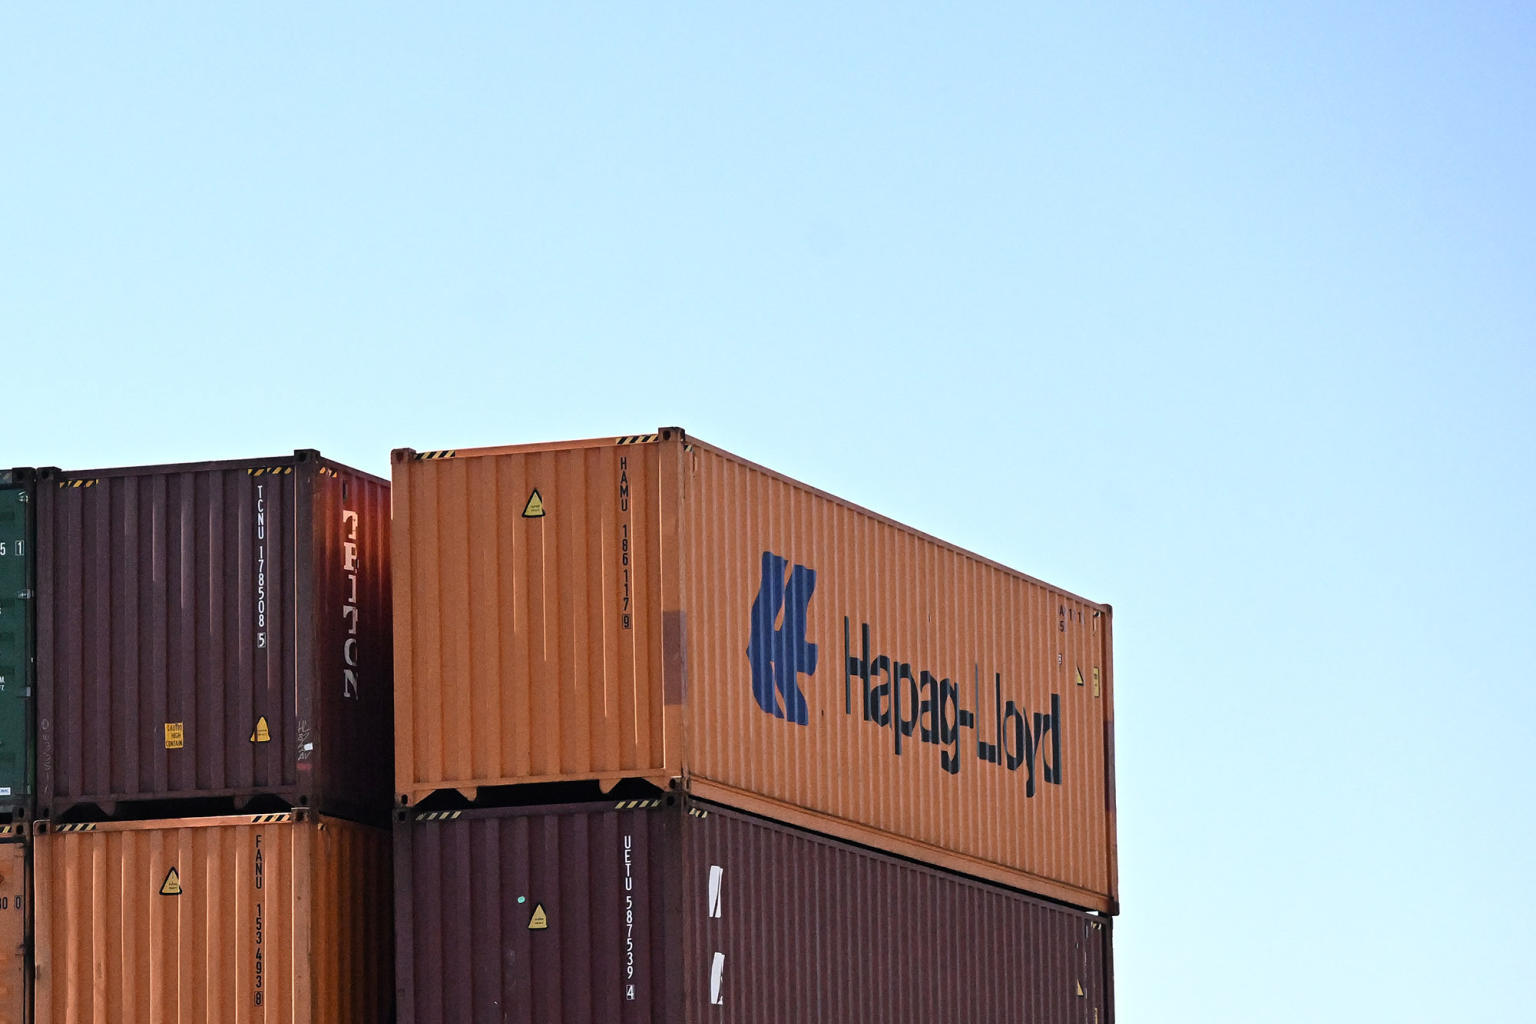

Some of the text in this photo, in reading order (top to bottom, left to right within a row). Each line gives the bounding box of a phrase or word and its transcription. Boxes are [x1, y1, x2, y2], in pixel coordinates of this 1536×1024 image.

[620, 457, 629, 512] HAMU
[257, 485, 265, 540] TCNU
[16, 540, 24, 555] 1
[623, 614, 631, 629] 9
[258, 633, 265, 648] 5
[844, 615, 1062, 798] Hapag-Lloyd
[624, 835, 632, 891] UETU
[15, 895, 23, 910] 0
[627, 985, 634, 1000] 4
